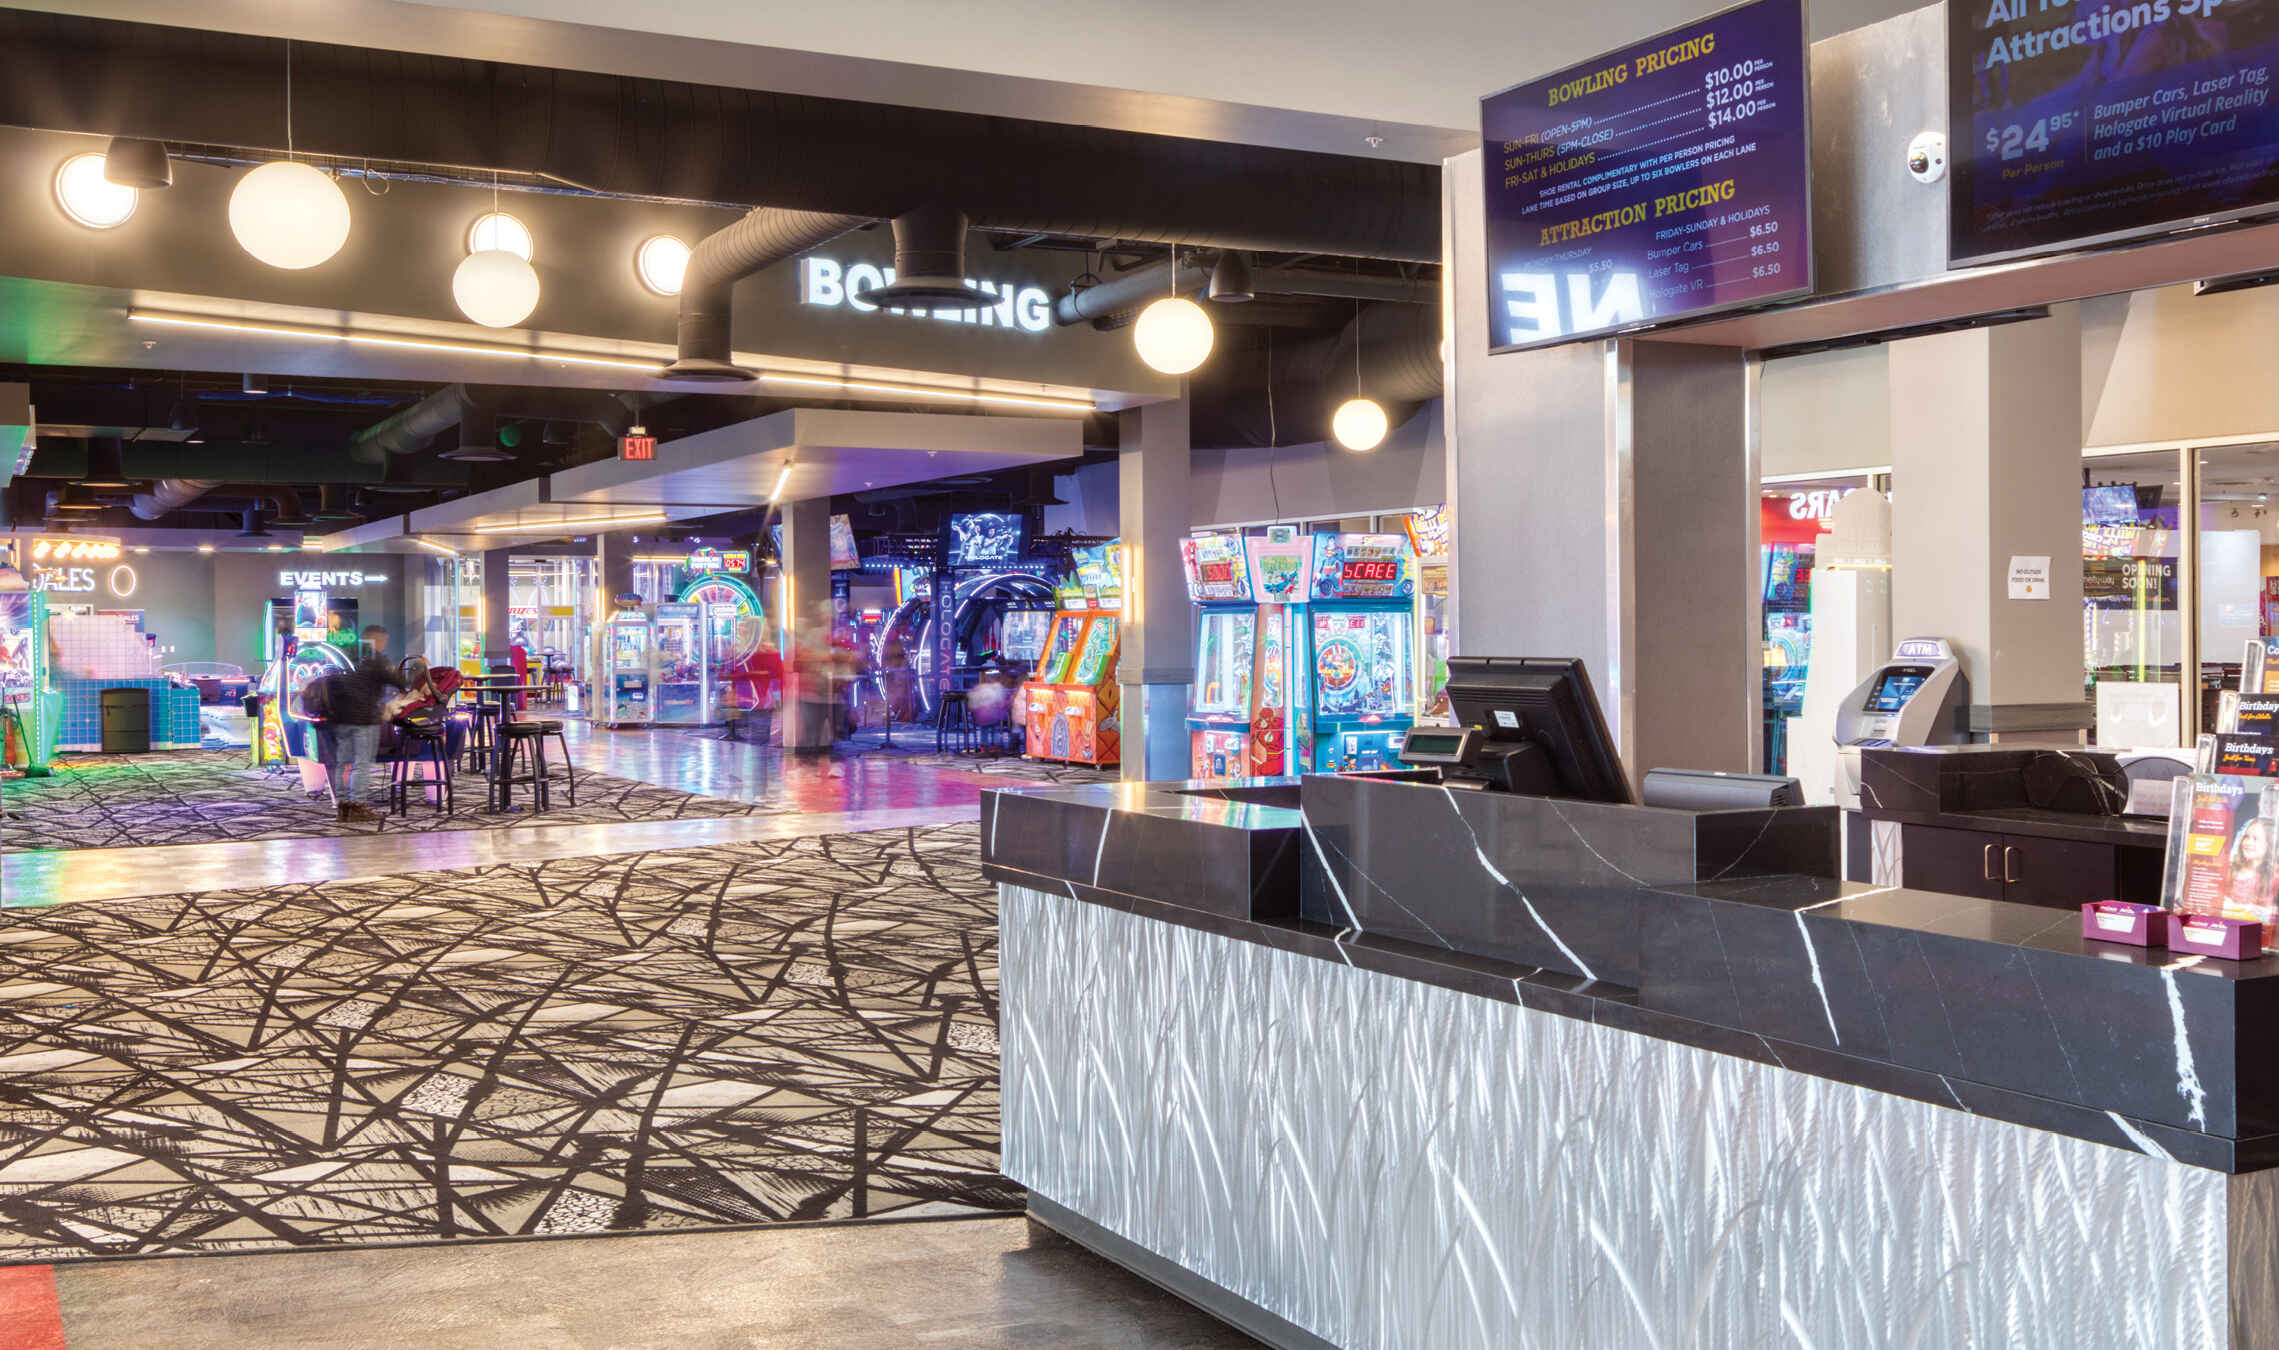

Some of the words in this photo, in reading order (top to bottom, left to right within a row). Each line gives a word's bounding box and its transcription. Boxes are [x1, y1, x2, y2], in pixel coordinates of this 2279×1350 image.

[1984, 0, 2171, 69] Attractions
[1548, 64, 1627, 106] BOWLING
[1635, 33, 1715, 77] PRICING
[1705, 60, 1753, 89] $10.00
[1706, 81, 1753, 109] $12.00
[2094, 96, 2149, 122] Bumper
[2152, 88, 2188, 107] Cars,
[2193, 73, 2234, 95] Laser
[2239, 66, 2269, 86] Tag,
[1708, 101, 1756, 129] $14.00
[2094, 115, 2157, 141] Hologate
[2161, 102, 2210, 125] Virtual
[2215, 87, 2269, 111] Reality
[2094, 139, 2120, 161] and
[2123, 140, 2134, 155] a
[2136, 132, 2162, 153] $10
[2166, 127, 2195, 148] Play
[2200, 115, 2236, 136] Card
[1550, 152, 1595, 176] HOLIDAYS
[1558, 180, 1581, 193] RENTAL
[1640, 158, 1658, 169] WITH
[1659, 153, 1673, 164] PER
[1675, 145, 1703, 159] PERSON
[1705, 135, 1735, 151] PRICING
[1577, 190, 1587, 199] ON
[1588, 184, 1611, 197] GROUP
[1630, 175, 1639, 185] UP
[1640, 173, 1650, 182] TO
[1652, 167, 1663, 179] SIX
[1664, 158, 1700, 176] BOWLERS
[1701, 154, 1712, 166] ON
[1714, 149, 1734, 162] EACH
[1735, 142, 1756, 156] LANE
[1540, 202, 1647, 247] ATTRACTION
[1655, 179, 1735, 218] PRICING
[1656, 218, 1718, 241] FRIDAY-SUNDAY
[1728, 204, 1770, 223] HOLIDAYS
[1750, 221, 1778, 238] $6.50
[1751, 241, 1779, 257] $6.50
[1752, 263, 1781, 279] $6.50
[801, 257, 1050, 332] BOING
[625, 437, 653, 459] EXIT
[280, 571, 363, 585] EVENTS
[2122, 564, 2171, 577] OPNING
[2122, 578, 2157, 589] SON!
[1908, 644, 1932, 656] ATM
[2225, 742, 2274, 755] Birthdays
[2196, 782, 2243, 797] Birthdays
